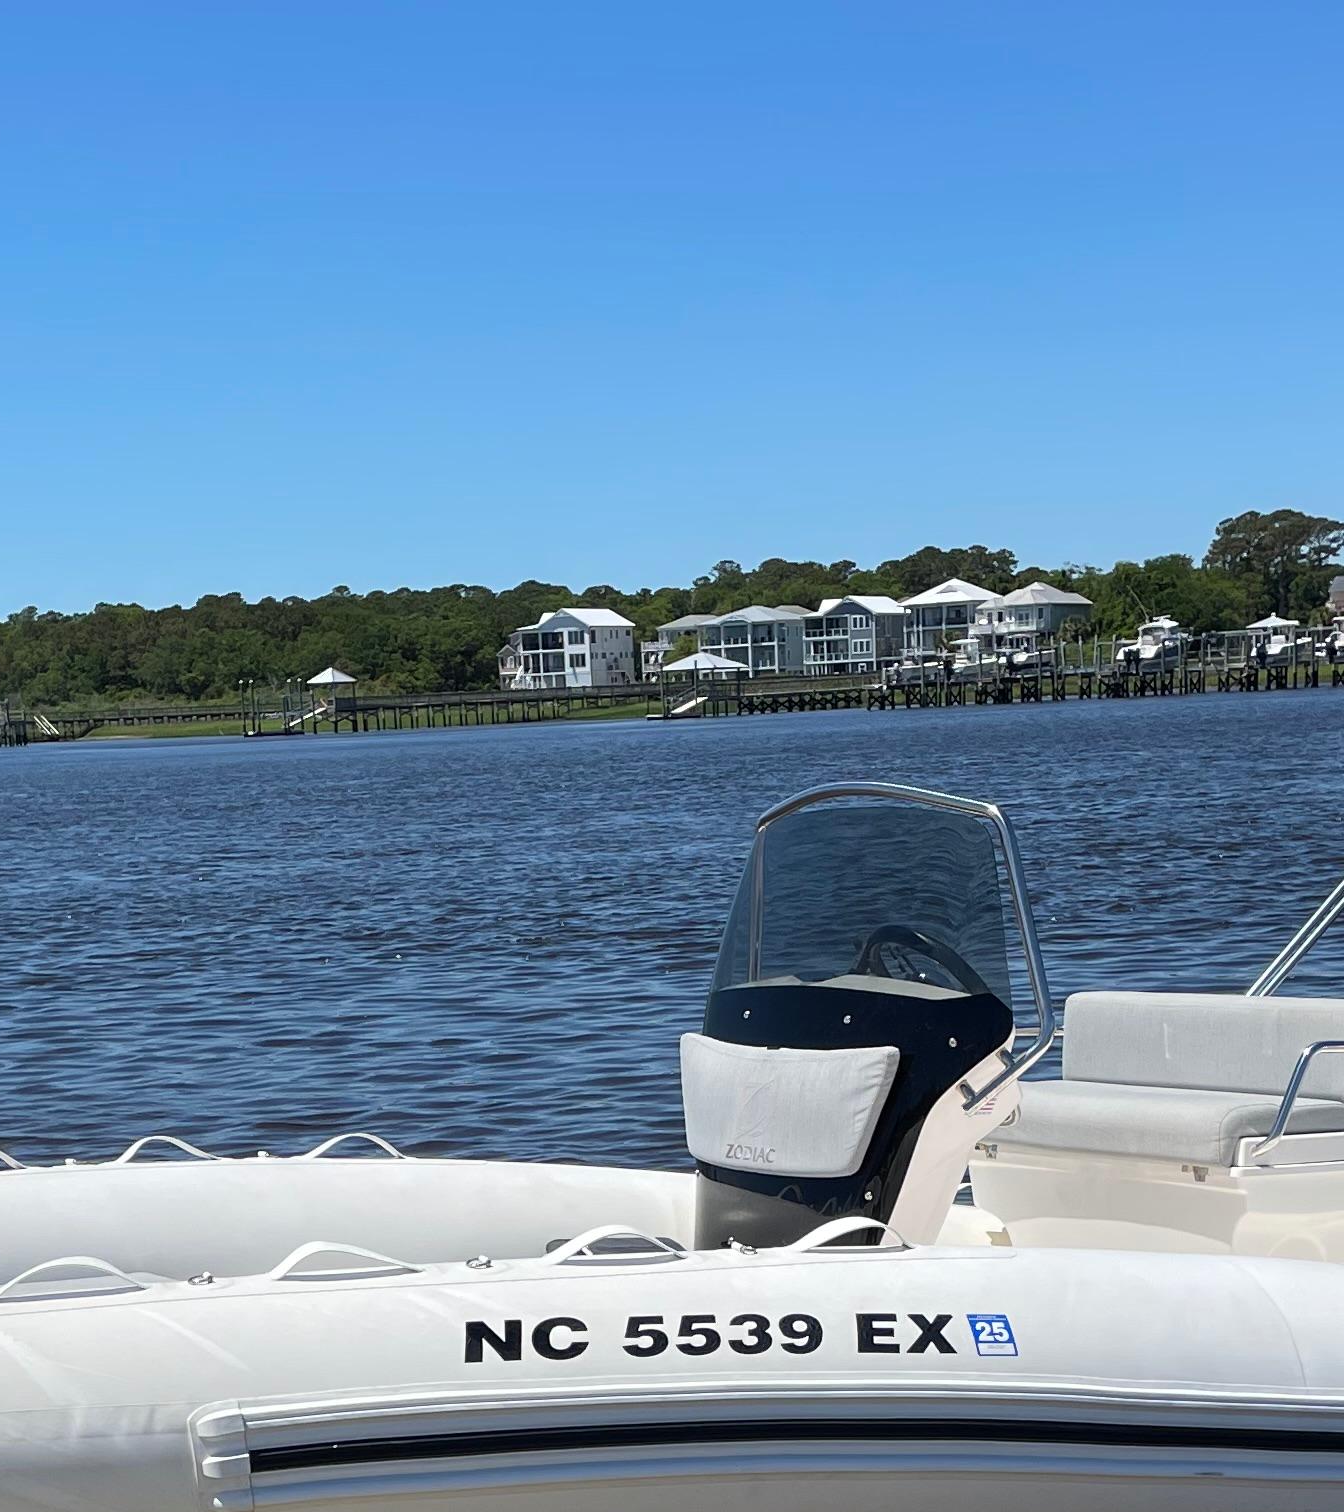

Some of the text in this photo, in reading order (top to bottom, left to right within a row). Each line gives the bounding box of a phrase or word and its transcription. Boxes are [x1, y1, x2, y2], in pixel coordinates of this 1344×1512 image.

[725, 1143, 776, 1164] ZODIAC
[464, 1313, 958, 1364] NC 5539 EX
[974, 1321, 1010, 1342] 25
